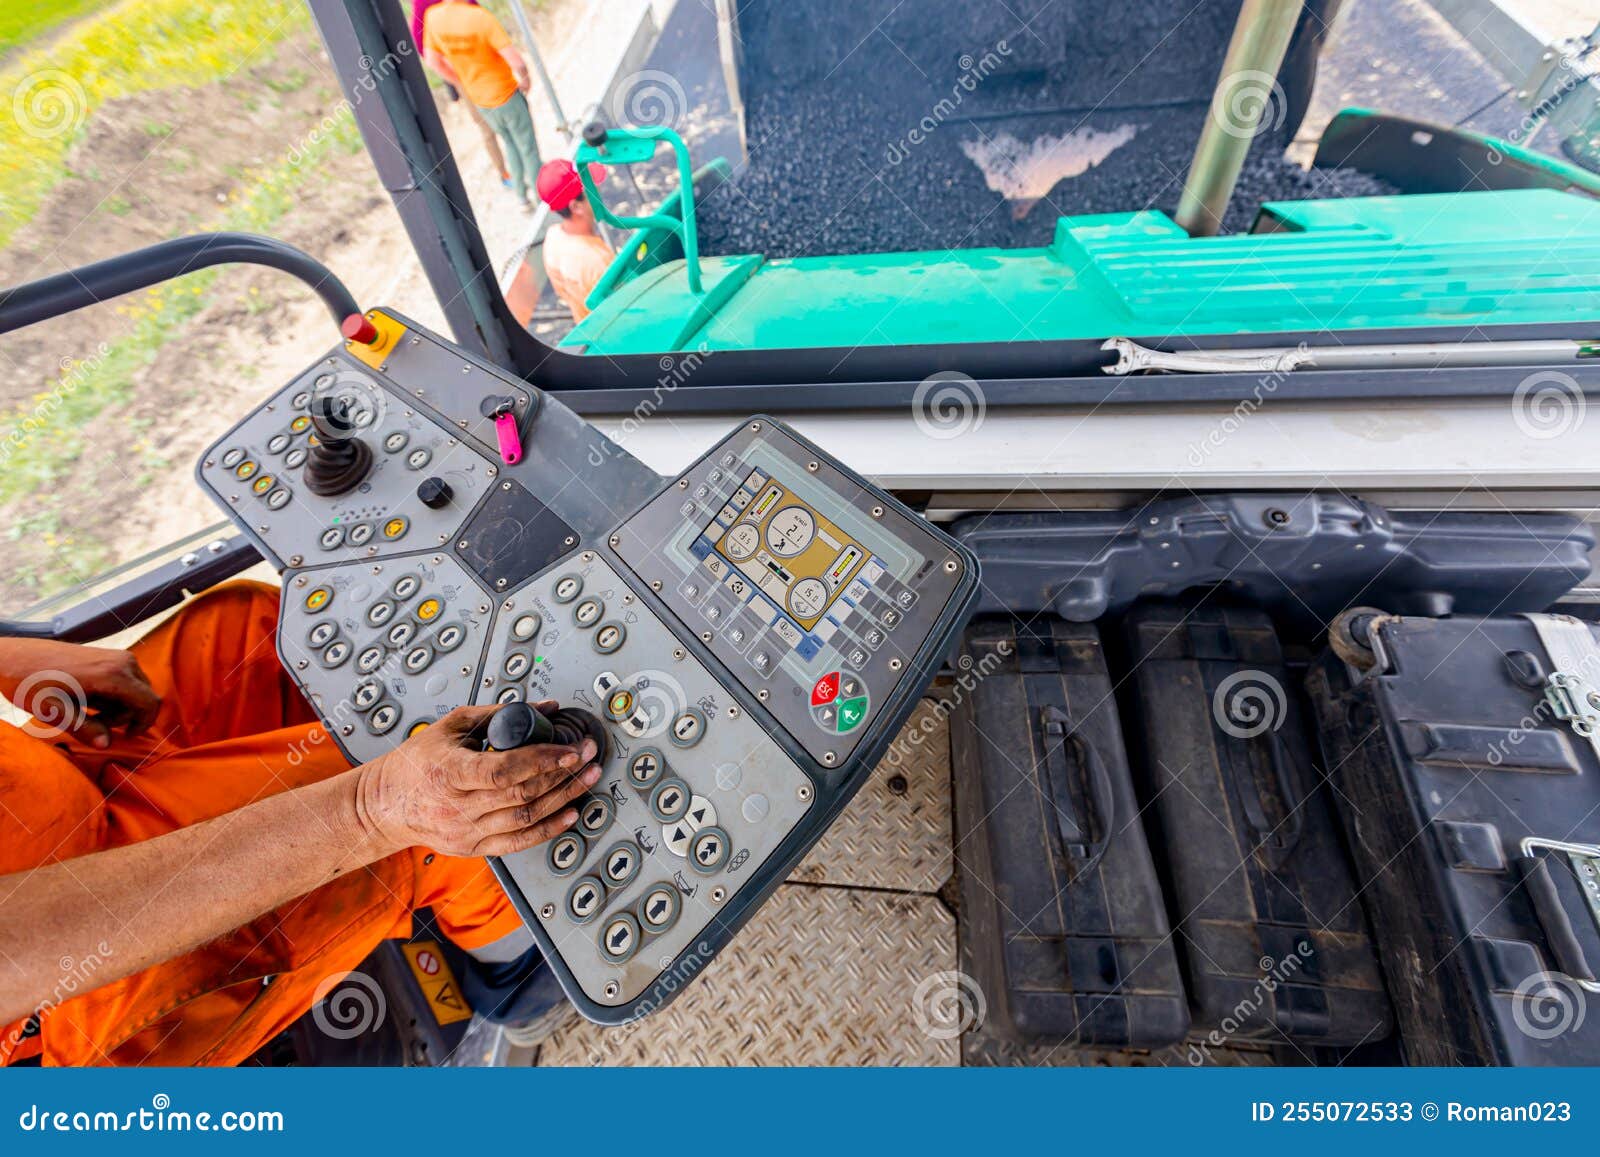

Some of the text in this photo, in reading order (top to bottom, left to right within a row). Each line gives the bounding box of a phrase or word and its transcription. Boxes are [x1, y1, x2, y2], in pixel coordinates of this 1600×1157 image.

[900, 591, 912, 604] F2
[884, 611, 896, 623] F4
[868, 631, 880, 643] F6
[851, 651, 863, 663] F8
[540, 670, 552, 684] ECO
[819, 681, 834, 697] ESC
